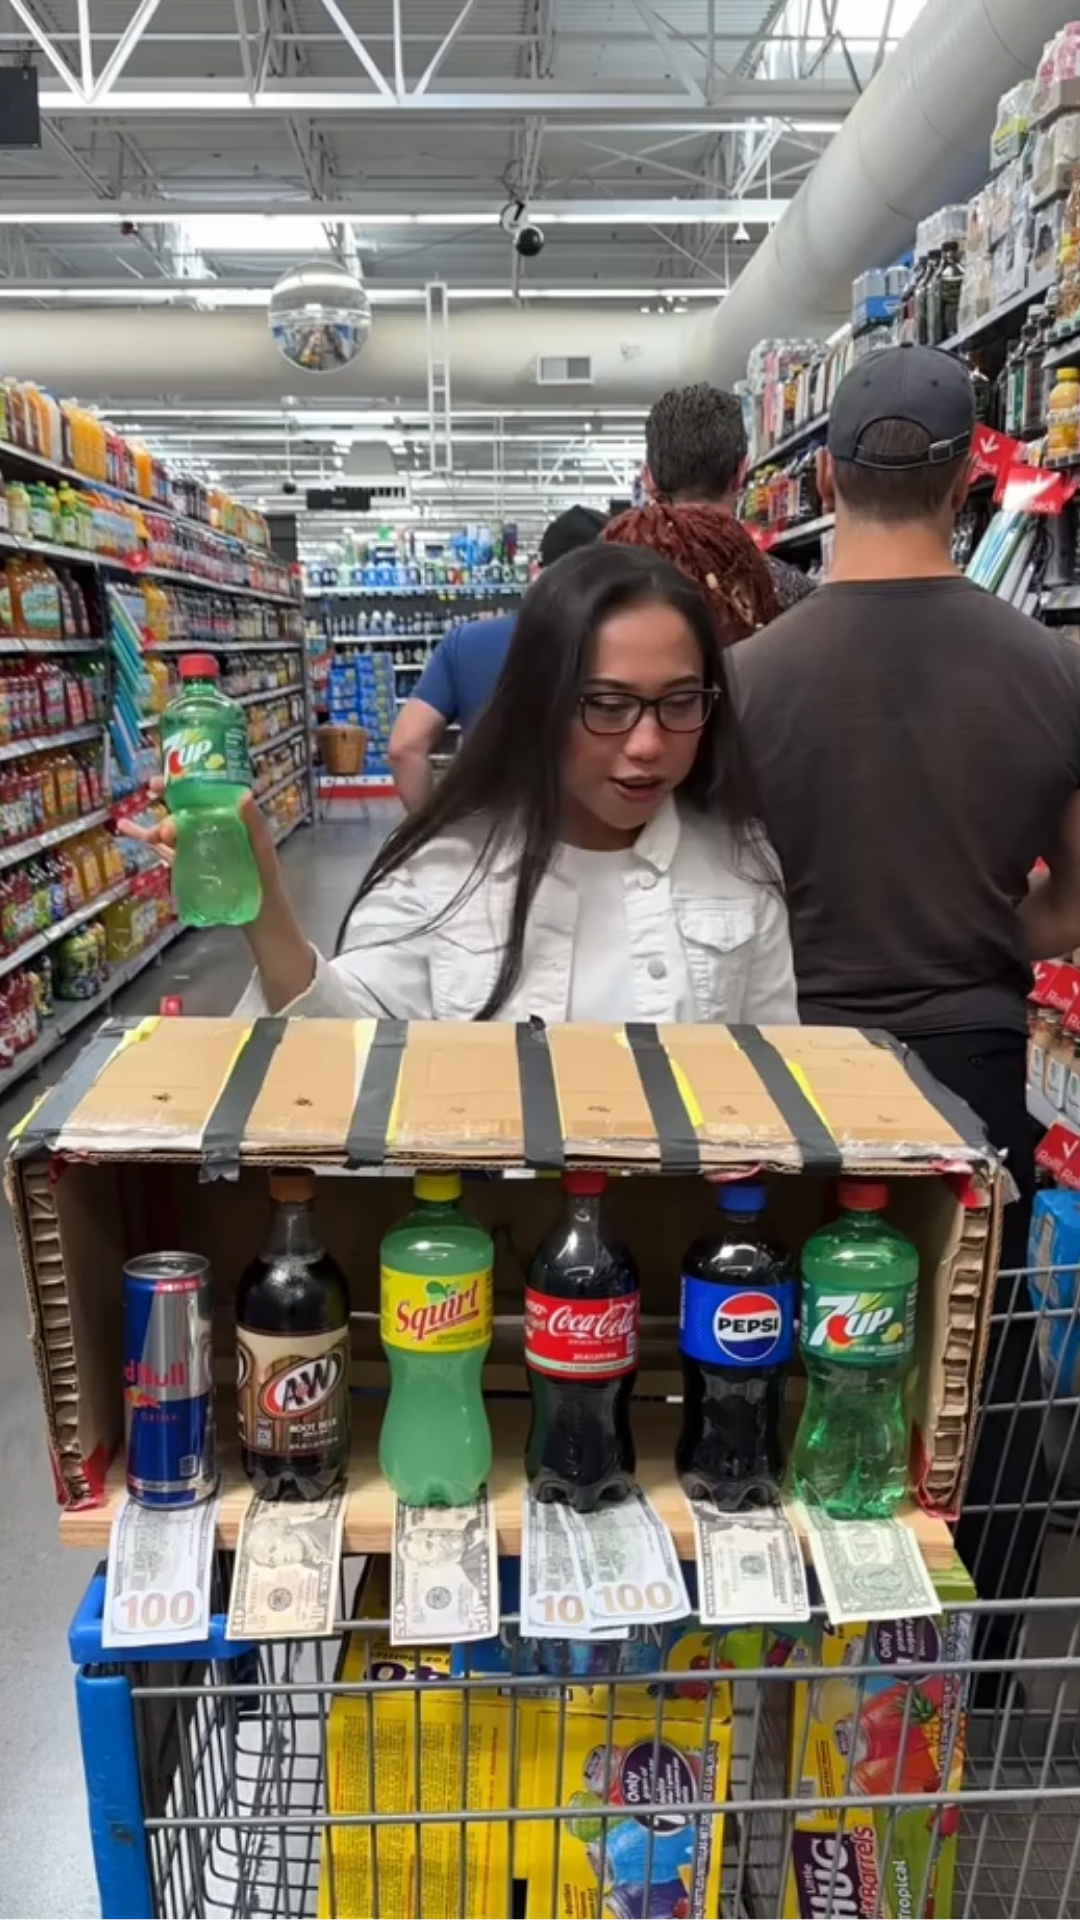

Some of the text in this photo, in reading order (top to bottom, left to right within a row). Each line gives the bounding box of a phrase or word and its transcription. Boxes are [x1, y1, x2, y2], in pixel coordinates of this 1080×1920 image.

[395, 1280, 477, 1341] Squirt
[548, 1301, 635, 1339] Coca-Cola
[717, 1316, 779, 1334] PEPSI
[808, 1294, 895, 1346] 7UP
[138, 1361, 185, 1386] Bull
[282, 1353, 334, 1412] A&W
[120, 1590, 196, 1629] 100
[537, 1594, 585, 1625] 10
[598, 1581, 674, 1613] 100
[879, 1630, 893, 1659] Only
[624, 1770, 641, 1802] Only
[802, 1863, 815, 1894] Little
[809, 1838, 858, 1919] HUG
[893, 1859, 913, 1918] Tropical
